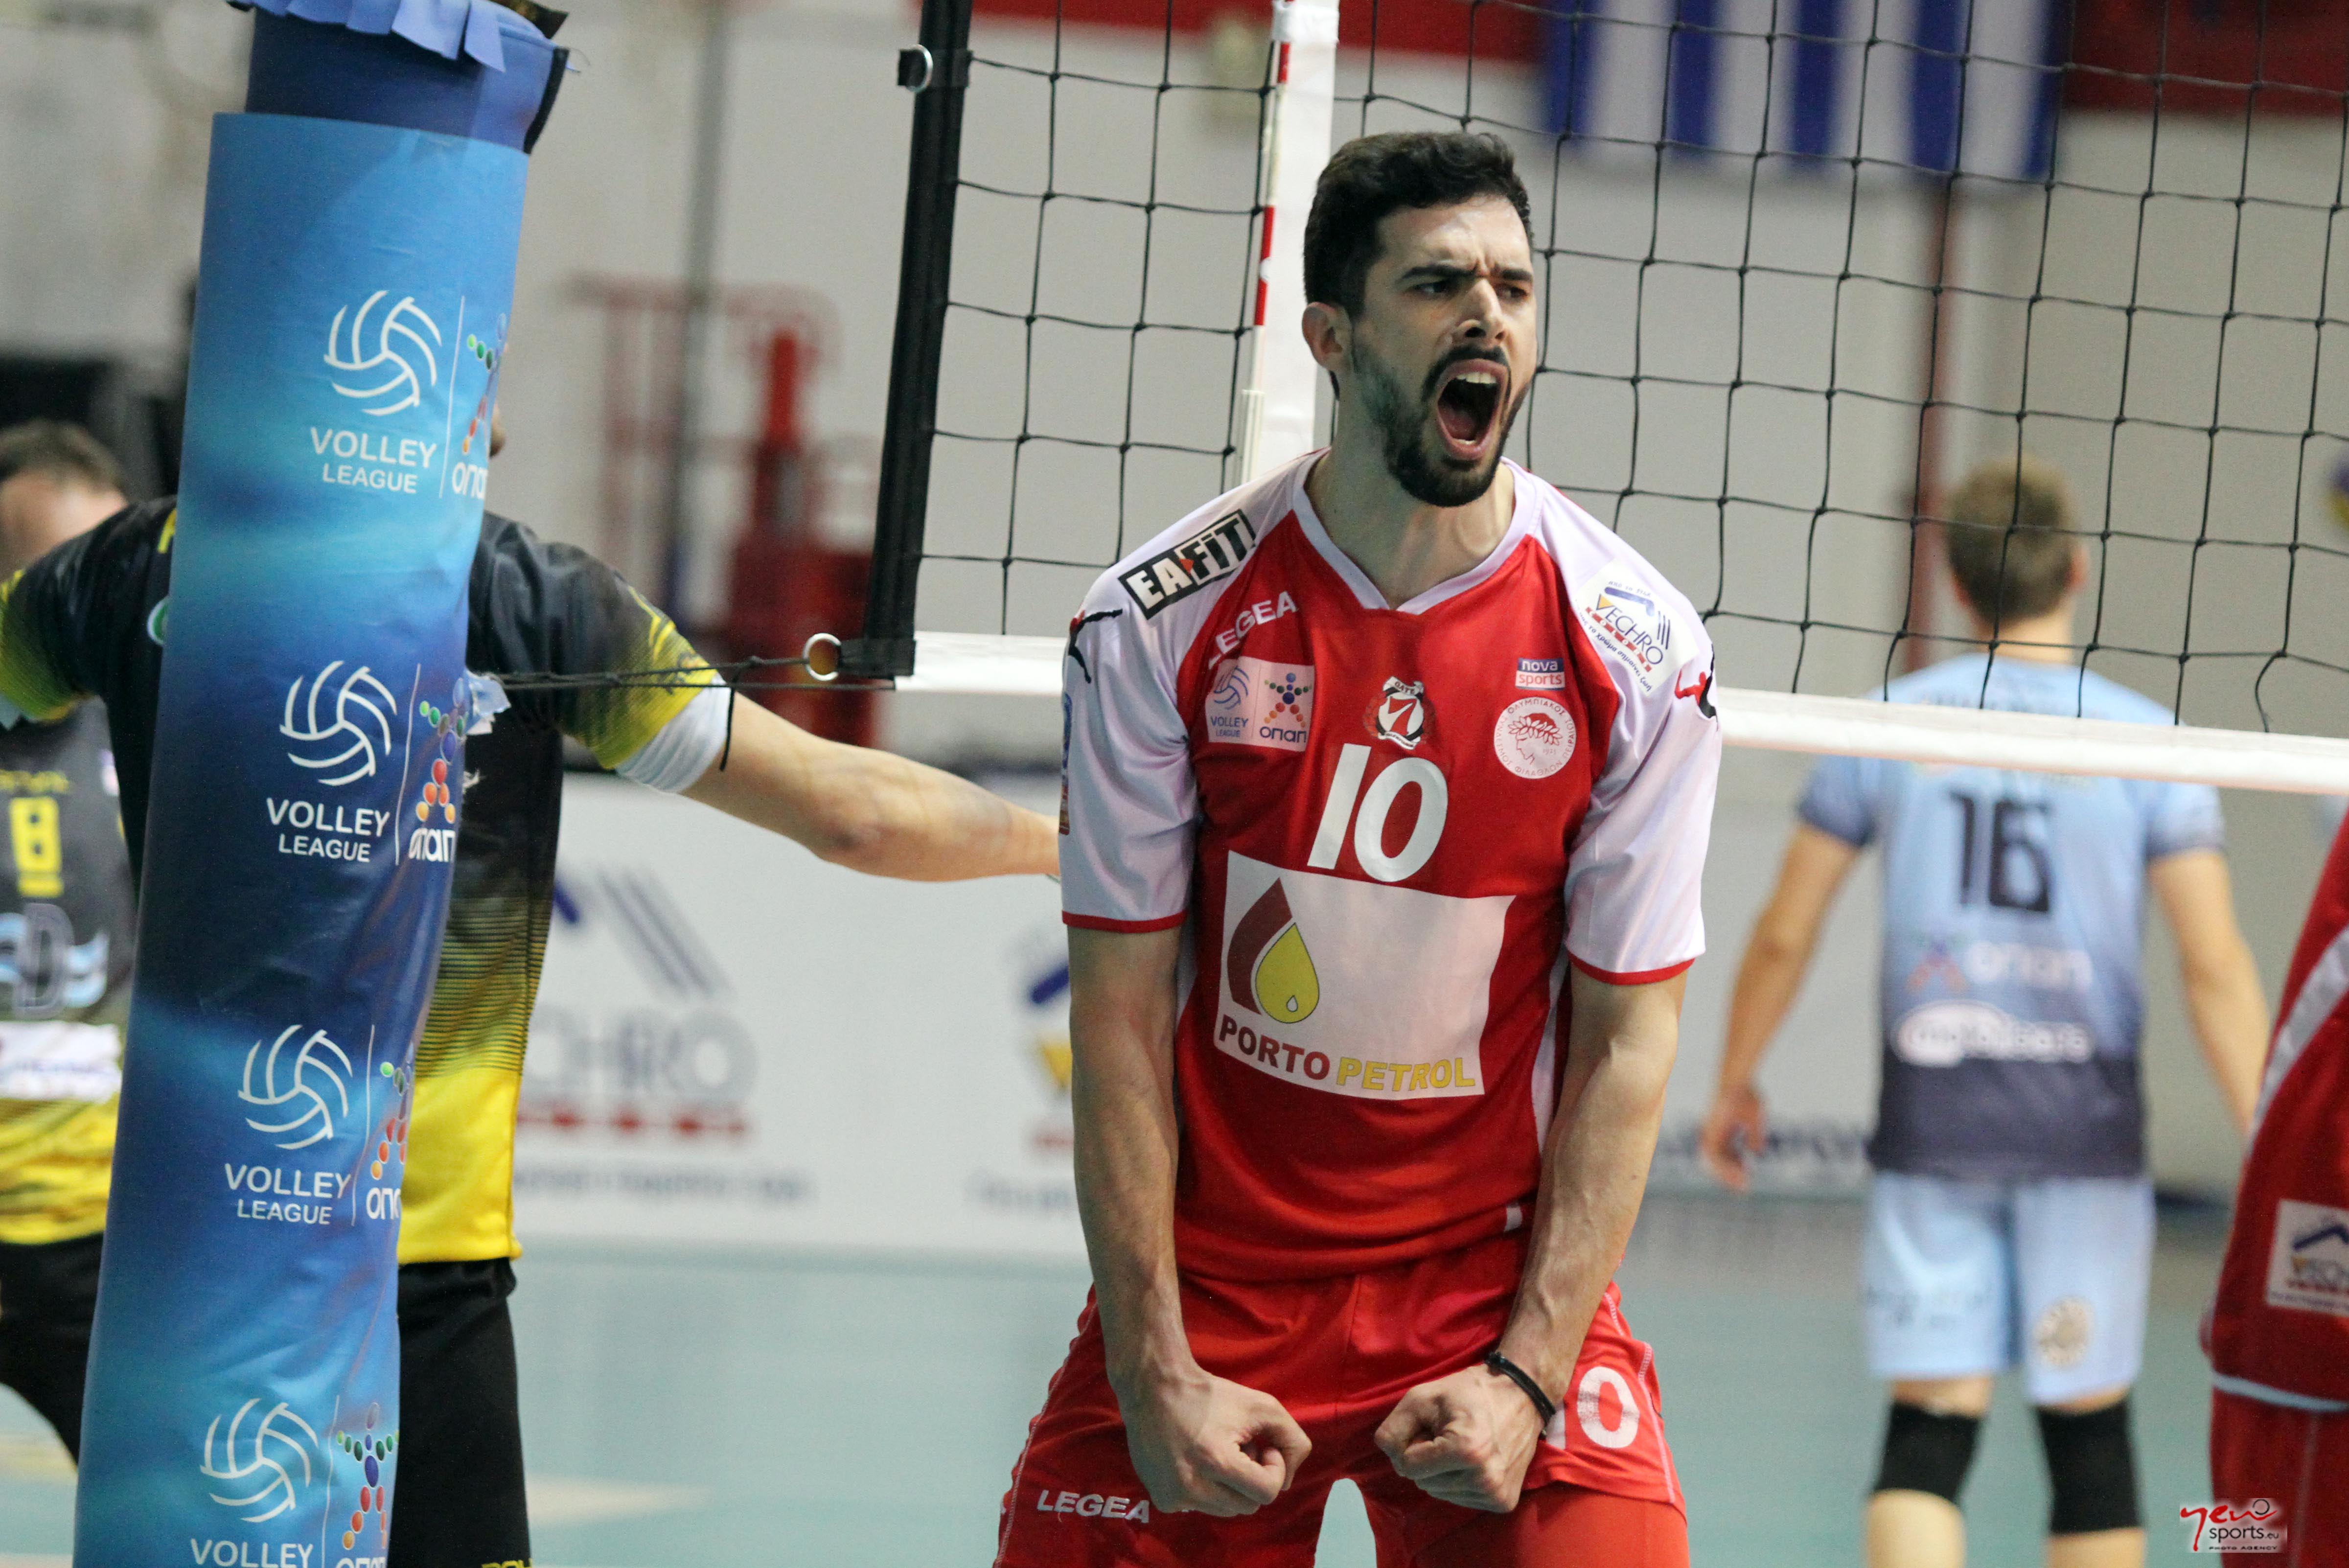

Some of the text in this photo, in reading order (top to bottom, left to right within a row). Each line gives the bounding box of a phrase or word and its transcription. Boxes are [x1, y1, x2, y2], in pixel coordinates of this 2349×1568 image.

[310, 427, 437, 468] VOLLEY
[322, 463, 418, 493] LEAGUE
[1596, 594, 1663, 664] VECHRO
[1518, 672, 1562, 686] sports
[1522, 660, 1558, 672] nova
[1211, 716, 1248, 727] VOLLEY
[266, 797, 390, 837] VOLLEY
[1307, 743, 1448, 882] 10
[10, 796, 63, 898] 8
[278, 834, 371, 863] LEAGUE
[1948, 791, 2053, 913] 16
[1219, 1014, 1476, 1092] PORTO PETROL
[225, 1163, 351, 1199] VOLLEY
[237, 1199, 333, 1224] LEAGUE
[1037, 1490, 1150, 1523] LEGEA
[190, 1538, 314, 1568] VOLLEY
